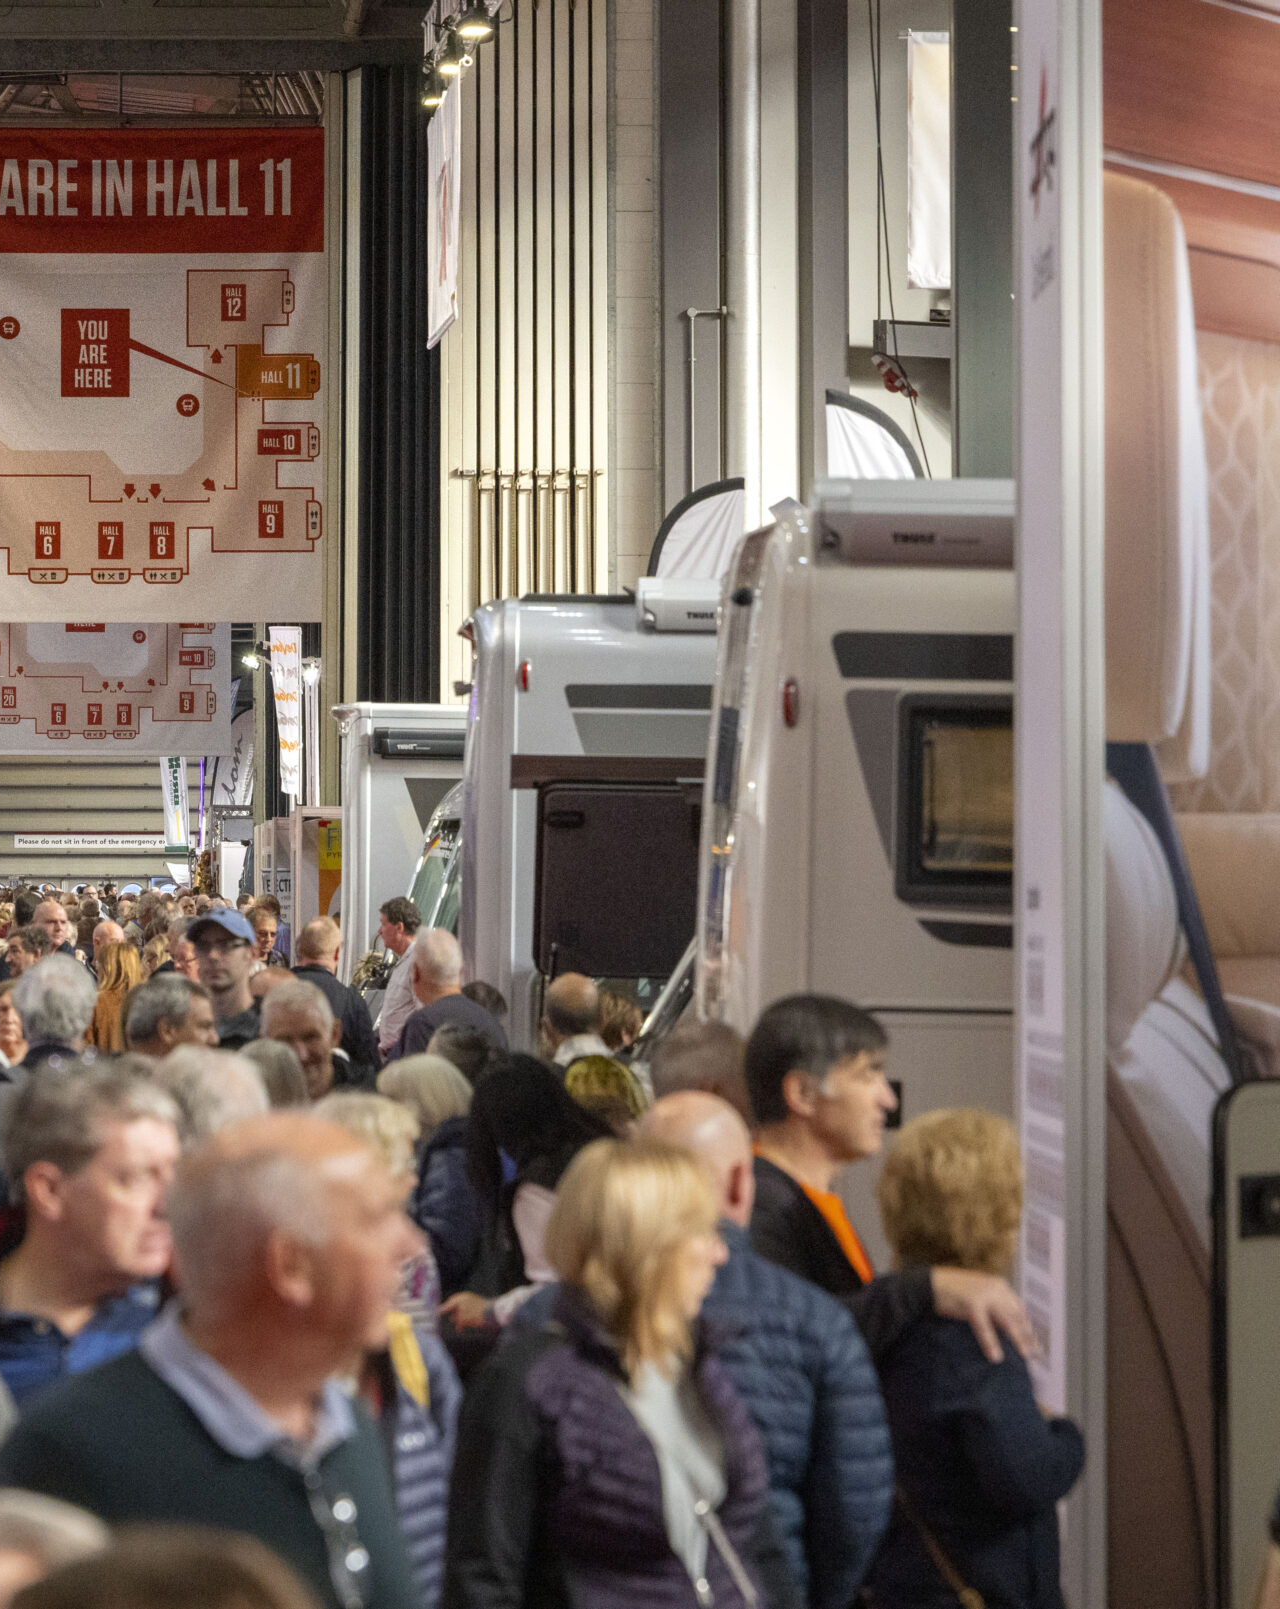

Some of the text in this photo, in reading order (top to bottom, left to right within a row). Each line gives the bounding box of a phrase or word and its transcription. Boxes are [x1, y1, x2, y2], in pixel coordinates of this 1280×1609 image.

[92, 158, 132, 217] IN
[147, 158, 248, 217] HALL
[260, 158, 292, 217] 11
[225, 287, 242, 298] HALL
[226, 298, 242, 317] 12
[78, 320, 108, 340] YOU
[78, 344, 108, 364] ARE
[74, 368, 112, 388] HERE
[261, 363, 301, 389] HALL 11
[262, 434, 295, 450] HALL 10
[262, 504, 279, 515] HALL
[39, 525, 56, 537] HALL
[102, 525, 119, 537] HALL
[153, 525, 170, 537] HALL
[266, 515, 276, 534] 9
[43, 537, 53, 556] 6
[106, 537, 115, 556] 7
[157, 537, 166, 556] 8
[194, 653, 201, 663] 10
[3, 694, 15, 707] 20
[183, 699, 190, 711] 9
[56, 711, 62, 723] 6
[92, 711, 98, 723] 7
[121, 711, 128, 723] 8
[120, 839, 157, 847] emergency
